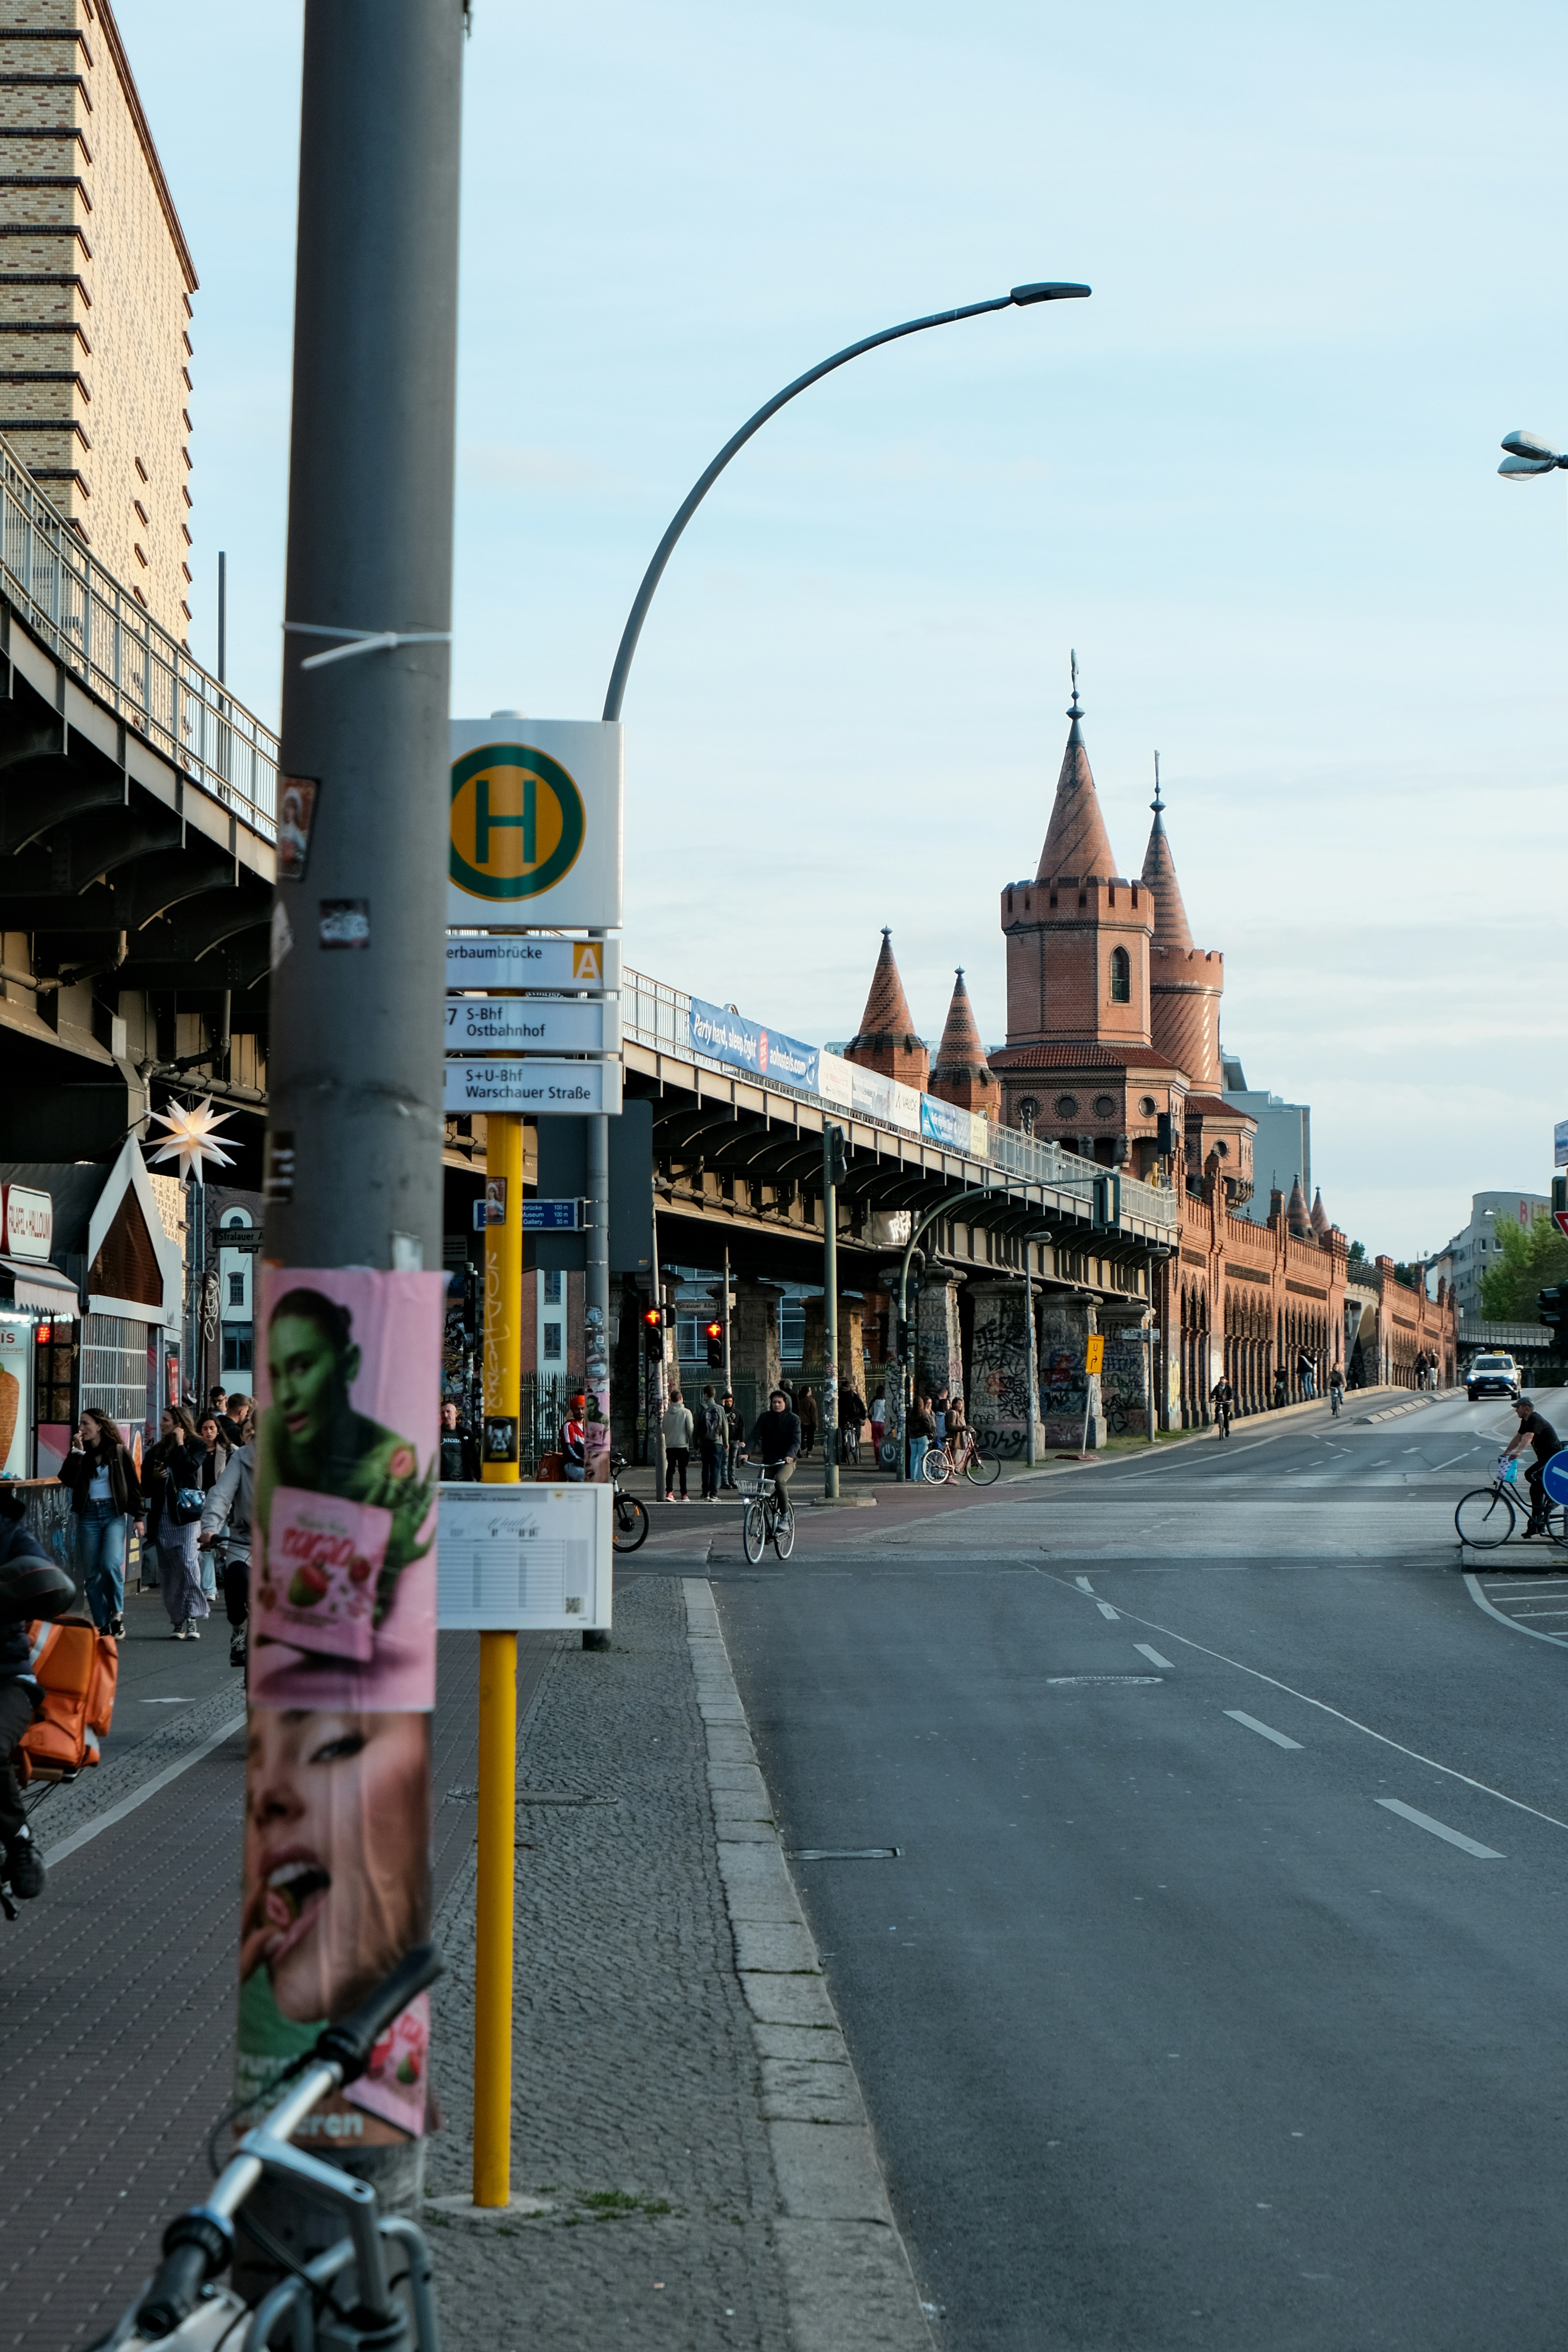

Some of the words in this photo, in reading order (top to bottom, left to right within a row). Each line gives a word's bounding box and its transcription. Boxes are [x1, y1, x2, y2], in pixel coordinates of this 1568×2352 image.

[476, 779, 536, 863] H
[446, 946, 542, 959] erbaumbrücke
[576, 948, 601, 979] A
[445, 1008, 457, 1025] 7
[467, 1007, 503, 1020] S-Bhf
[467, 1024, 545, 1037] Ostbahnhof
[694, 1013, 712, 1045] Party
[712, 1020, 728, 1050] hard,
[729, 1027, 743, 1056] sleep
[744, 1033, 756, 1061] tight
[466, 1069, 523, 1082] S+U-Bhf
[466, 1085, 544, 1099] Warschauer
[549, 1086, 591, 1099] Straße
[218, 1232, 254, 1241] Stralauer
